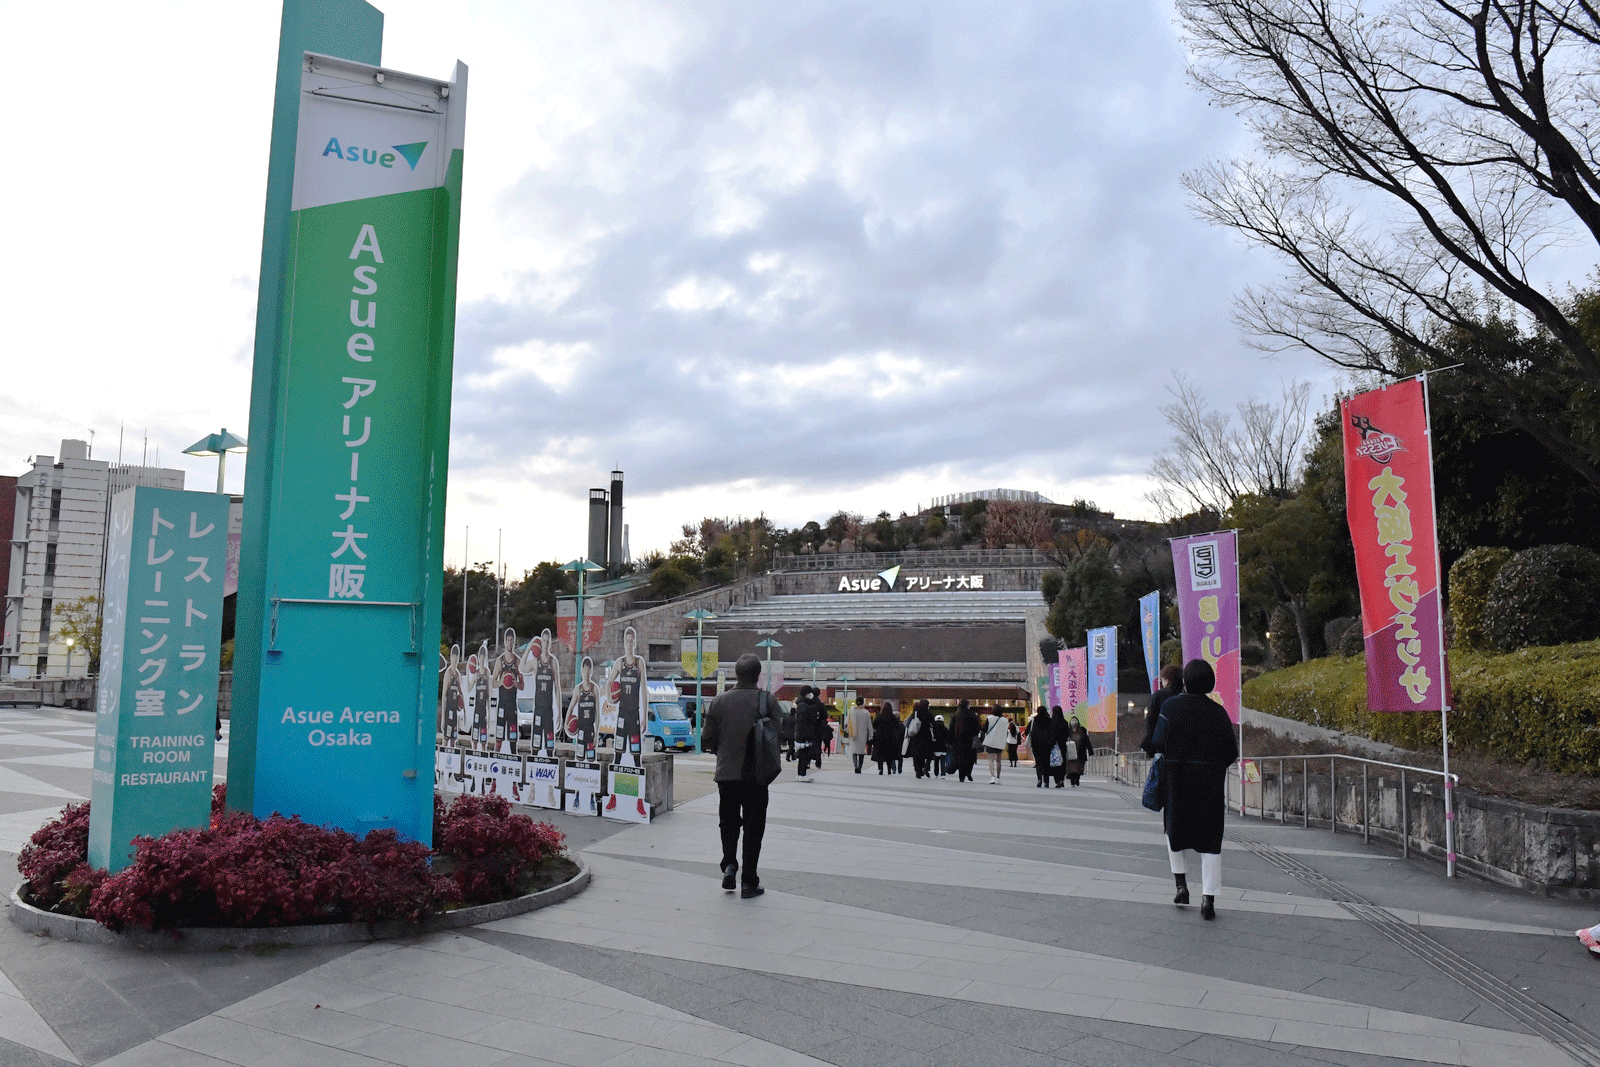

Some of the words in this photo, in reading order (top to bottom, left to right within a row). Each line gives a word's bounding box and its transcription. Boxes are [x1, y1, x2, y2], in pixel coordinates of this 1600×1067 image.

[321, 136, 396, 169] Asue
[837, 576, 882, 592] Asue
[905, 575, 984, 590] アリーナ大阪
[133, 507, 176, 717] トレーニング室
[177, 511, 216, 716] レストラン
[281, 706, 334, 724] Asue
[339, 706, 400, 724] Arena
[129, 735, 205, 749] TRAINING
[308, 728, 372, 746] Osaka
[143, 750, 191, 764] ROOM
[120, 770, 208, 786] RESTAURANT
